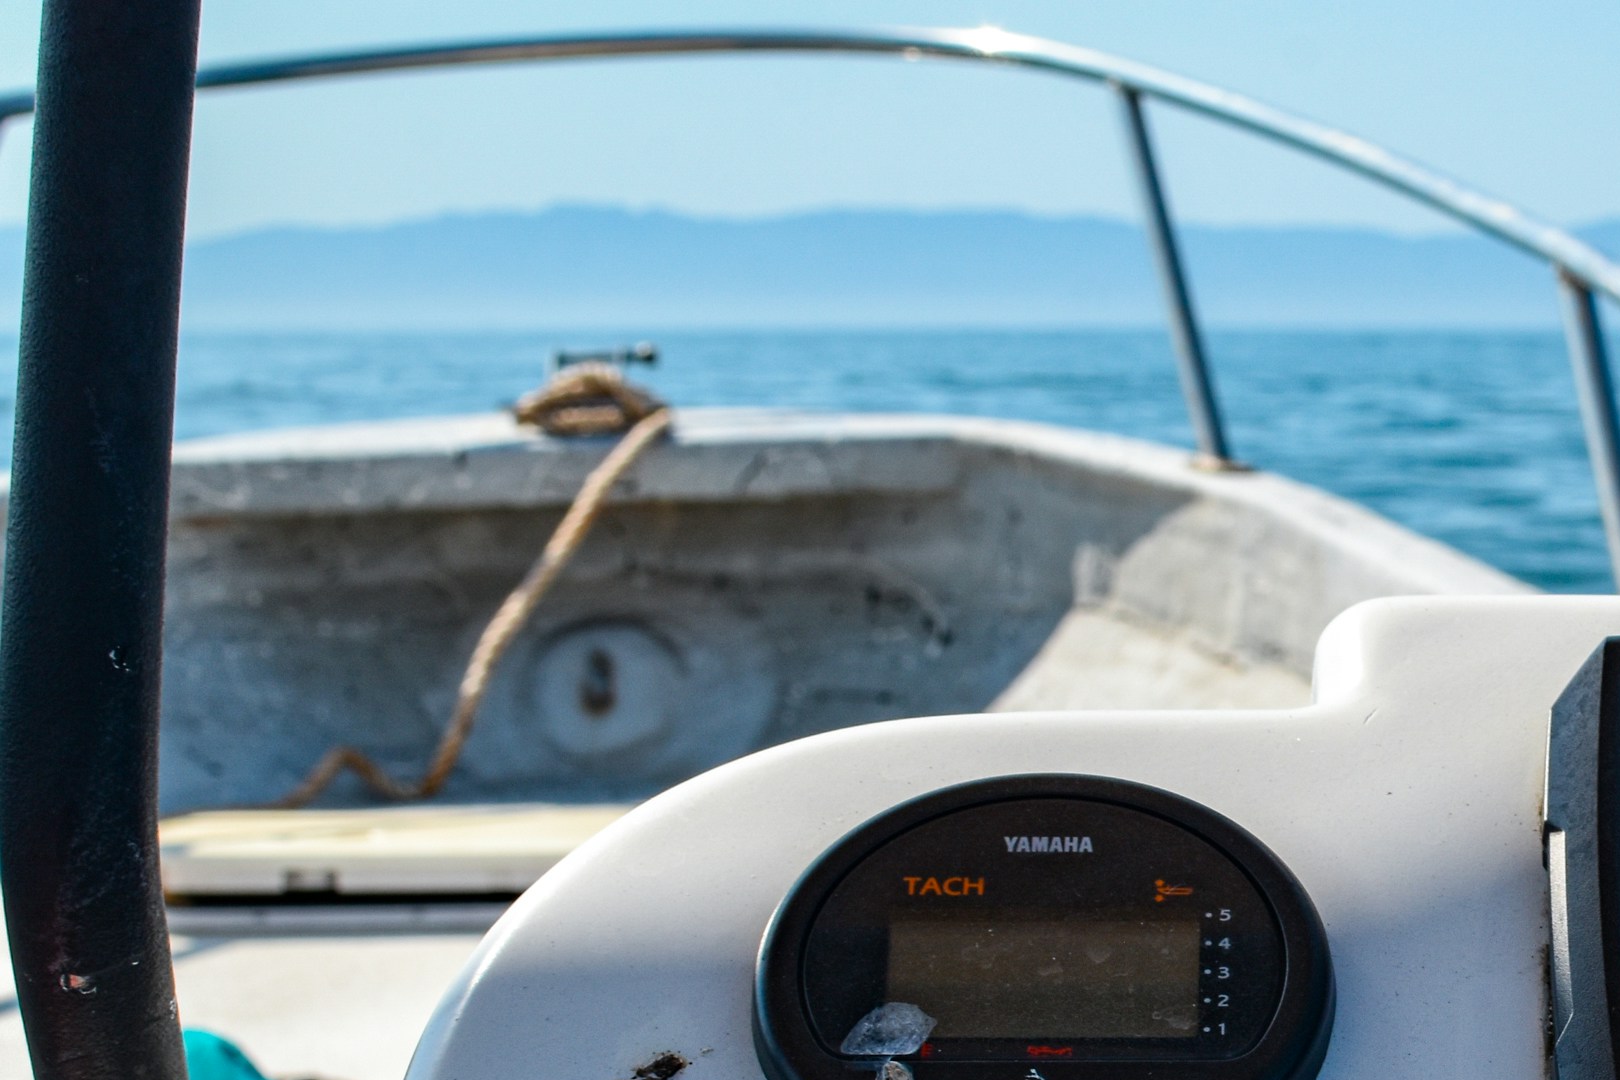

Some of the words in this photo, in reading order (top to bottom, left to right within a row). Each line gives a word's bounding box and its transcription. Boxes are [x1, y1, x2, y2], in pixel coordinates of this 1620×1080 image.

[1003, 836, 1094, 853] YAMAHA
[903, 877, 985, 896] TACH
[1219, 909, 1231, 922] 5
[1217, 937, 1231, 950] 4
[1217, 966, 1230, 979] 3
[1217, 994, 1229, 1007] 2
[1218, 1022, 1226, 1035] 1
